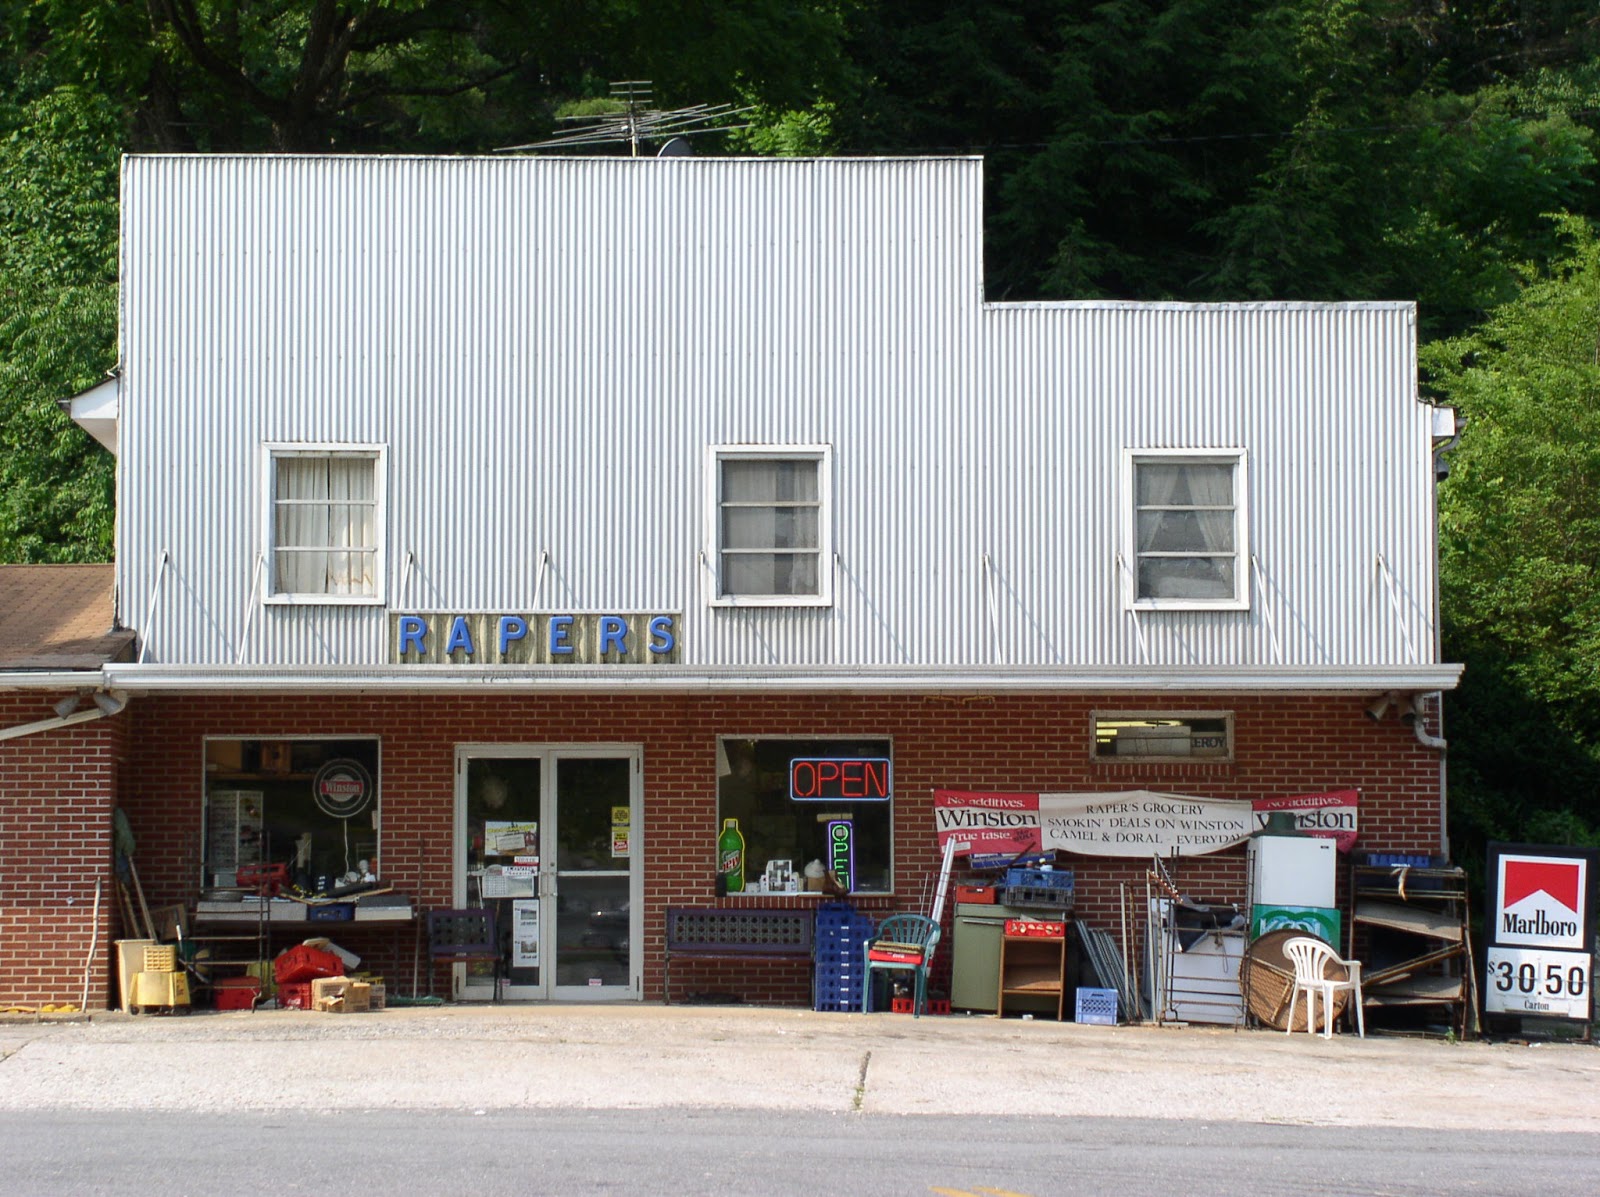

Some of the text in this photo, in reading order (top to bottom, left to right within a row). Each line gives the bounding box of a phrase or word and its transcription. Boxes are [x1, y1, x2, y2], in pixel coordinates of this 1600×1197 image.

[399, 615, 676, 656] RAPERS
[1191, 736, 1225, 748] EROY
[794, 762, 888, 797] OPEN
[325, 781, 360, 793] Winston
[947, 797, 1026, 808] No additives.
[1086, 802, 1205, 815] RAPER'S GROCERY
[938, 809, 1037, 828] Winston
[1048, 818, 1244, 830] SMOKIN' DEALS ON WINSTON
[1256, 810, 1354, 829] nston
[950, 832, 1013, 842] True taste.
[1050, 829, 1098, 841] CAMEL
[1102, 833, 1111, 842] &
[1116, 832, 1163, 844] DORAL
[1503, 909, 1577, 936] Marlboro
[1488, 961, 1585, 996] $30.50
[1524, 1000, 1550, 1010] Carton
